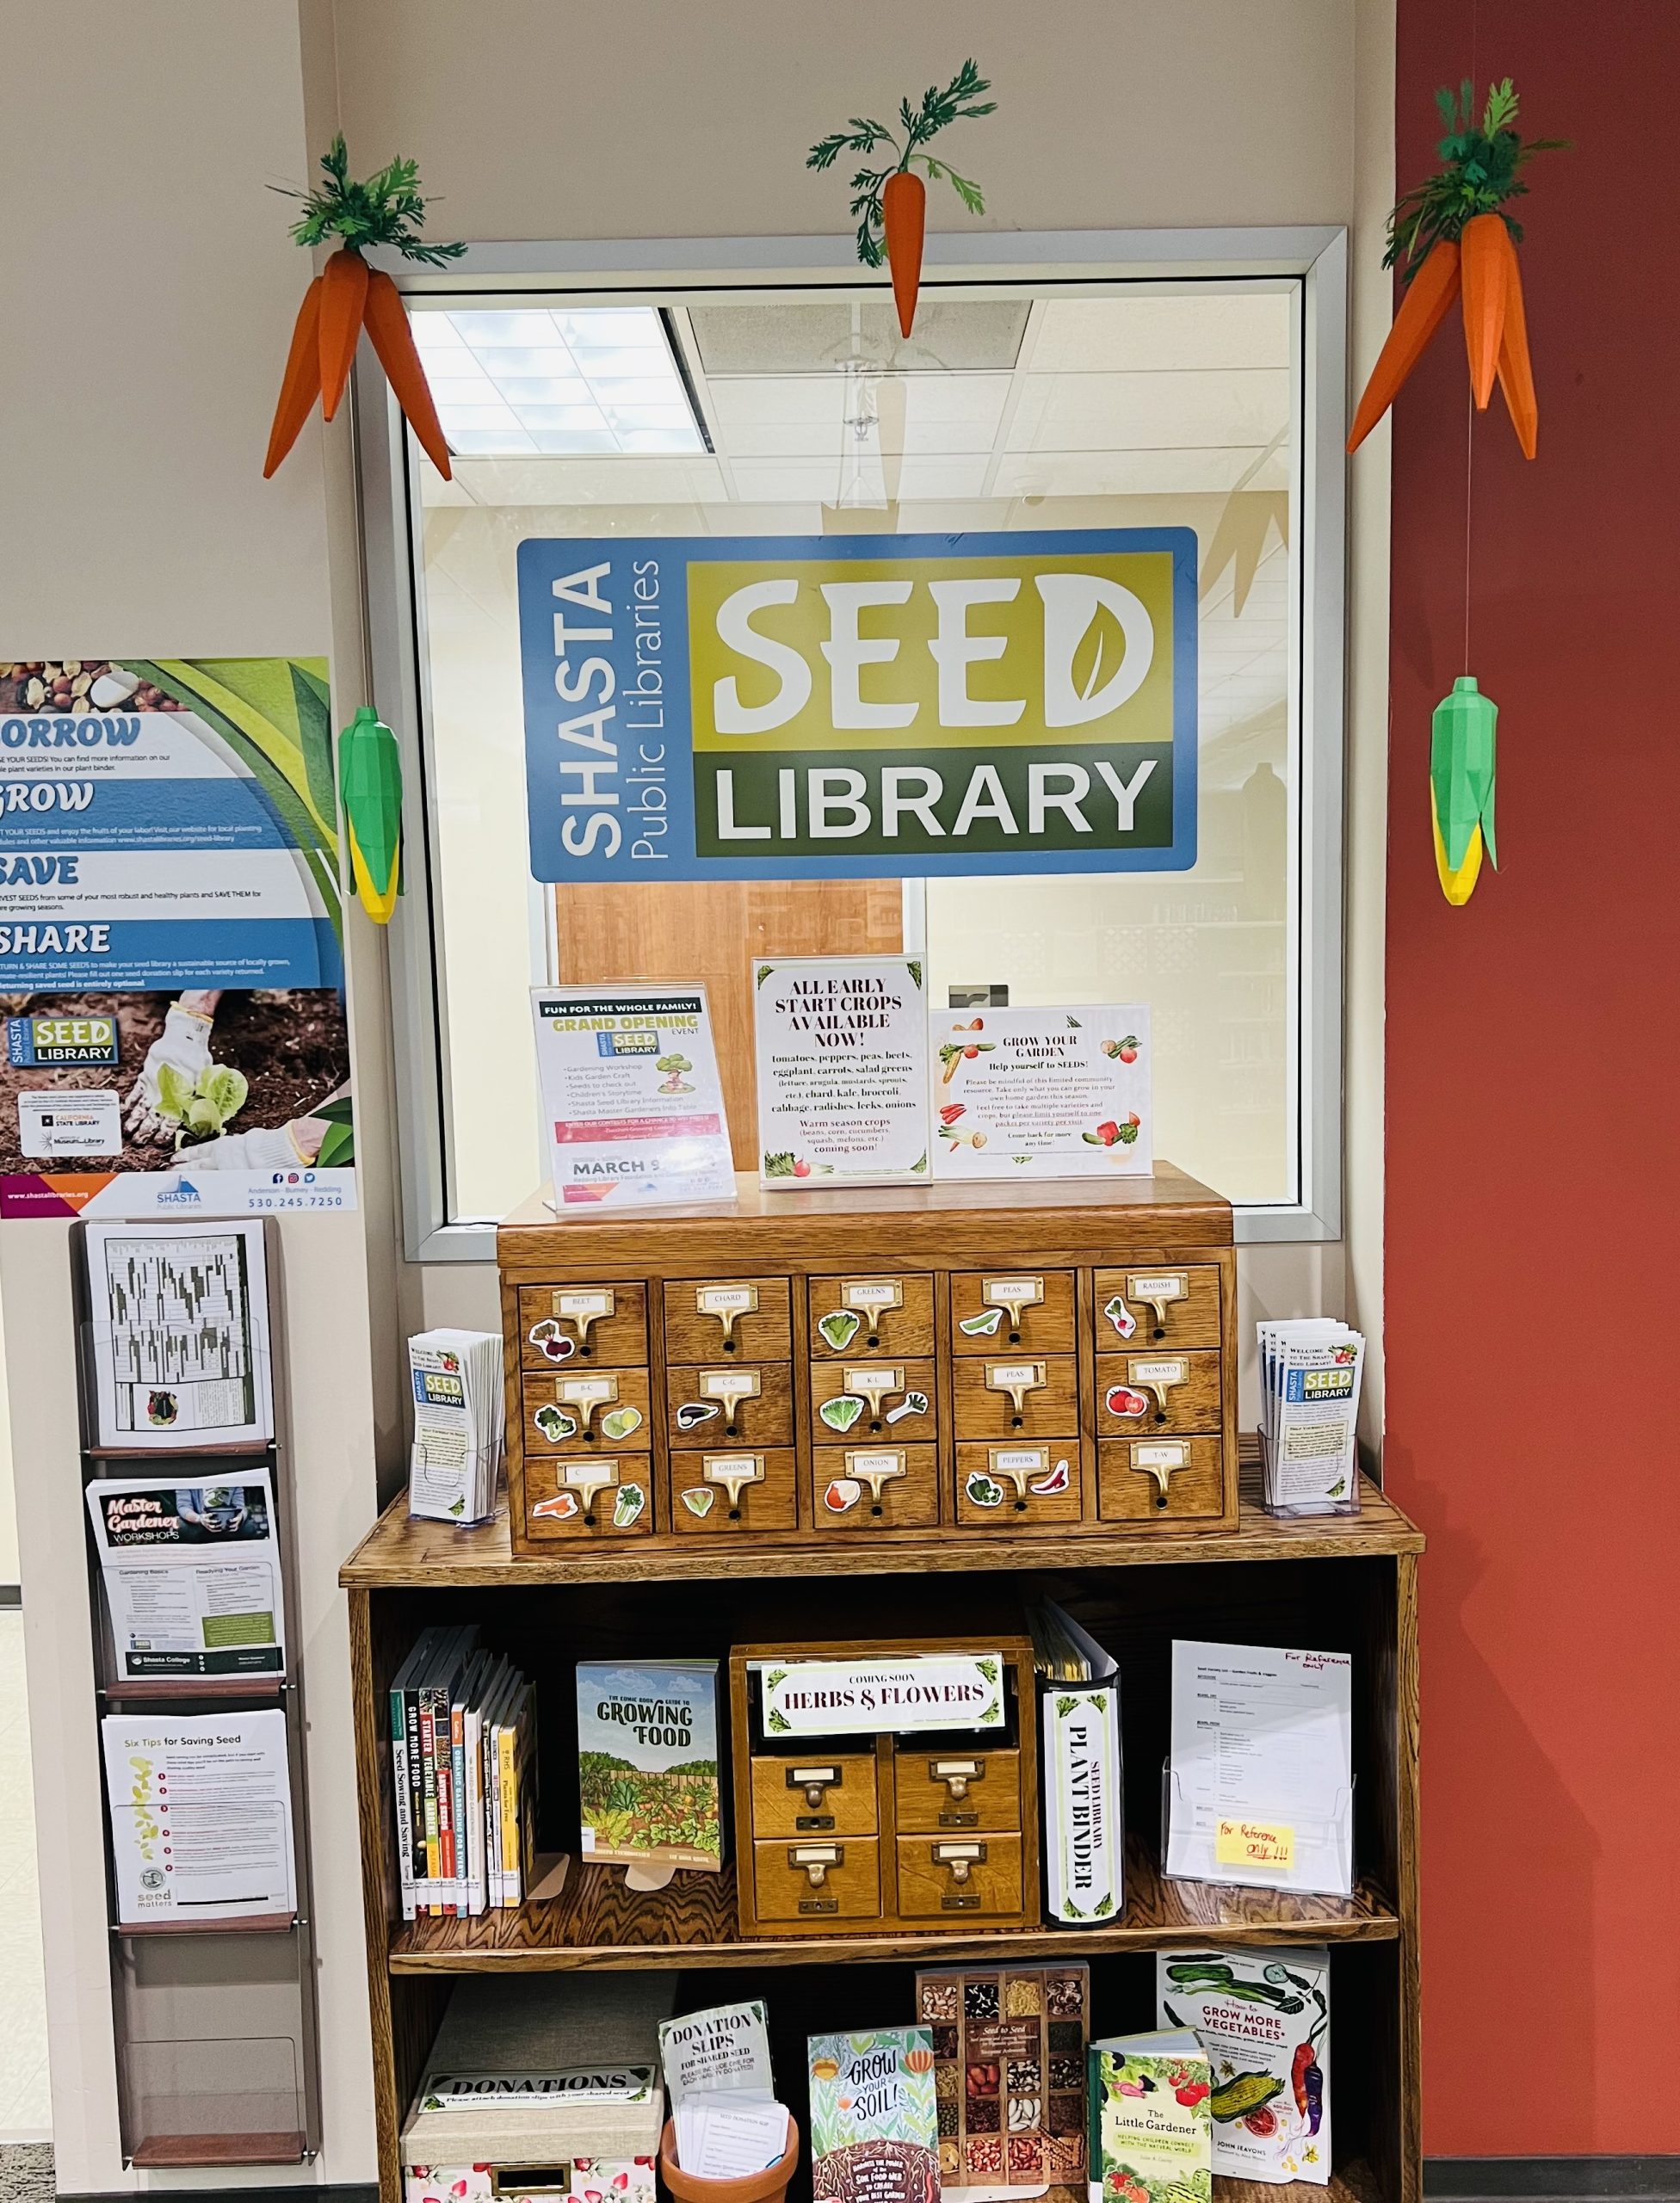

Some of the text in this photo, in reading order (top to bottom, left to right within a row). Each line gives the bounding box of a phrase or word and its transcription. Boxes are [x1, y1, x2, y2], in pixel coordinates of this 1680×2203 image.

[713, 573, 1154, 735] SEED
[552, 561, 621, 858] SHASTA
[624, 559, 669, 860] Public Libraries
[715, 760, 1158, 841] LIBRARY
[0, 924, 111, 954] SHARE
[788, 978, 887, 995] ALL EARLY
[615, 1003, 654, 1012] WHOLE
[655, 1002, 696, 1010] FAMILY!
[775, 995, 902, 1013] START CROPS
[552, 1014, 698, 1032] GRAND OPENING
[788, 1013, 891, 1030] AVAILABLE
[36, 1021, 110, 1045] SEED
[614, 1033, 655, 1046] SEED
[670, 1027, 699, 1035] EVENT
[814, 1032, 863, 1047] NOW!
[10, 1020, 23, 1063] SHASTA
[1003, 1035, 1078, 1046] GROW YOUR
[37, 1047, 112, 1060] LIBRARY
[615, 1046, 657, 1054] LIBRARY
[1016, 1046, 1064, 1057] GARDEN
[989, 1062, 1009, 1072] Help
[1010, 1061, 1046, 1070] yourself
[573, 1160, 644, 1175] MARCH
[156, 1192, 201, 1203] SHASTA
[248, 1196, 342, 1207] 530.245.7250
[856, 1285, 886, 1295] GREENS
[426, 1375, 460, 1394] SEED
[1288, 1371, 1298, 1401] SHASTA
[1306, 1370, 1350, 1389] SEED
[428, 1392, 462, 1405] LIBRARY
[1305, 1387, 1350, 1399] LIBRARY
[718, 1463, 748, 1472] GREENS
[862, 1456, 889, 1466] ONION
[107, 1498, 162, 1515] Master
[108, 1514, 180, 1533] Gardener
[114, 1532, 180, 1543] WORKSHOPS
[1285, 1652, 1300, 1661] For
[849, 1673, 915, 1684] COMING SOON
[784, 1683, 985, 1711] HERBS & FLOWERS
[597, 1700, 693, 1726] GROWING
[124, 1735, 241, 1748] Six Tips for Saving Seed
[633, 1725, 691, 1748] FOOD
[408, 1706, 421, 1787] GROW MORE FOOD
[395, 1749, 404, 1771] Seed
[423, 1720, 435, 1836] STARTER VEGETABLE GARDENS
[397, 1774, 406, 1806] Sowing
[439, 1774, 448, 1830] SAVING SEEDS
[1069, 1726, 1092, 1889] PLANT BINDER
[1090, 1761, 1102, 1848] SEED LIBRARY
[1220, 1821, 1277, 1844] For Reference
[400, 1827, 410, 1857] Saving
[137, 1891, 171, 1902] seed
[1224, 1999, 1246, 2010] How
[1202, 2006, 1282, 2029] GROW MORE
[672, 2013, 751, 2045] DONATION
[982, 2026, 1000, 2035] Seed
[1009, 2024, 1027, 2034] Seed
[691, 2033, 734, 2056] SLIPS
[681, 2047, 750, 2070] FOR SHARED SEED
[844, 2050, 897, 2086] GROW
[451, 2074, 627, 2095] DONATIONS
[862, 2077, 886, 2095] YOUR
[851, 2083, 898, 2120] SOIL!
[1147, 2108, 1164, 2119] The
[1115, 2116, 1196, 2135] Little Gardener
[1216, 2139, 1266, 2156] JOHN JEAVONS
